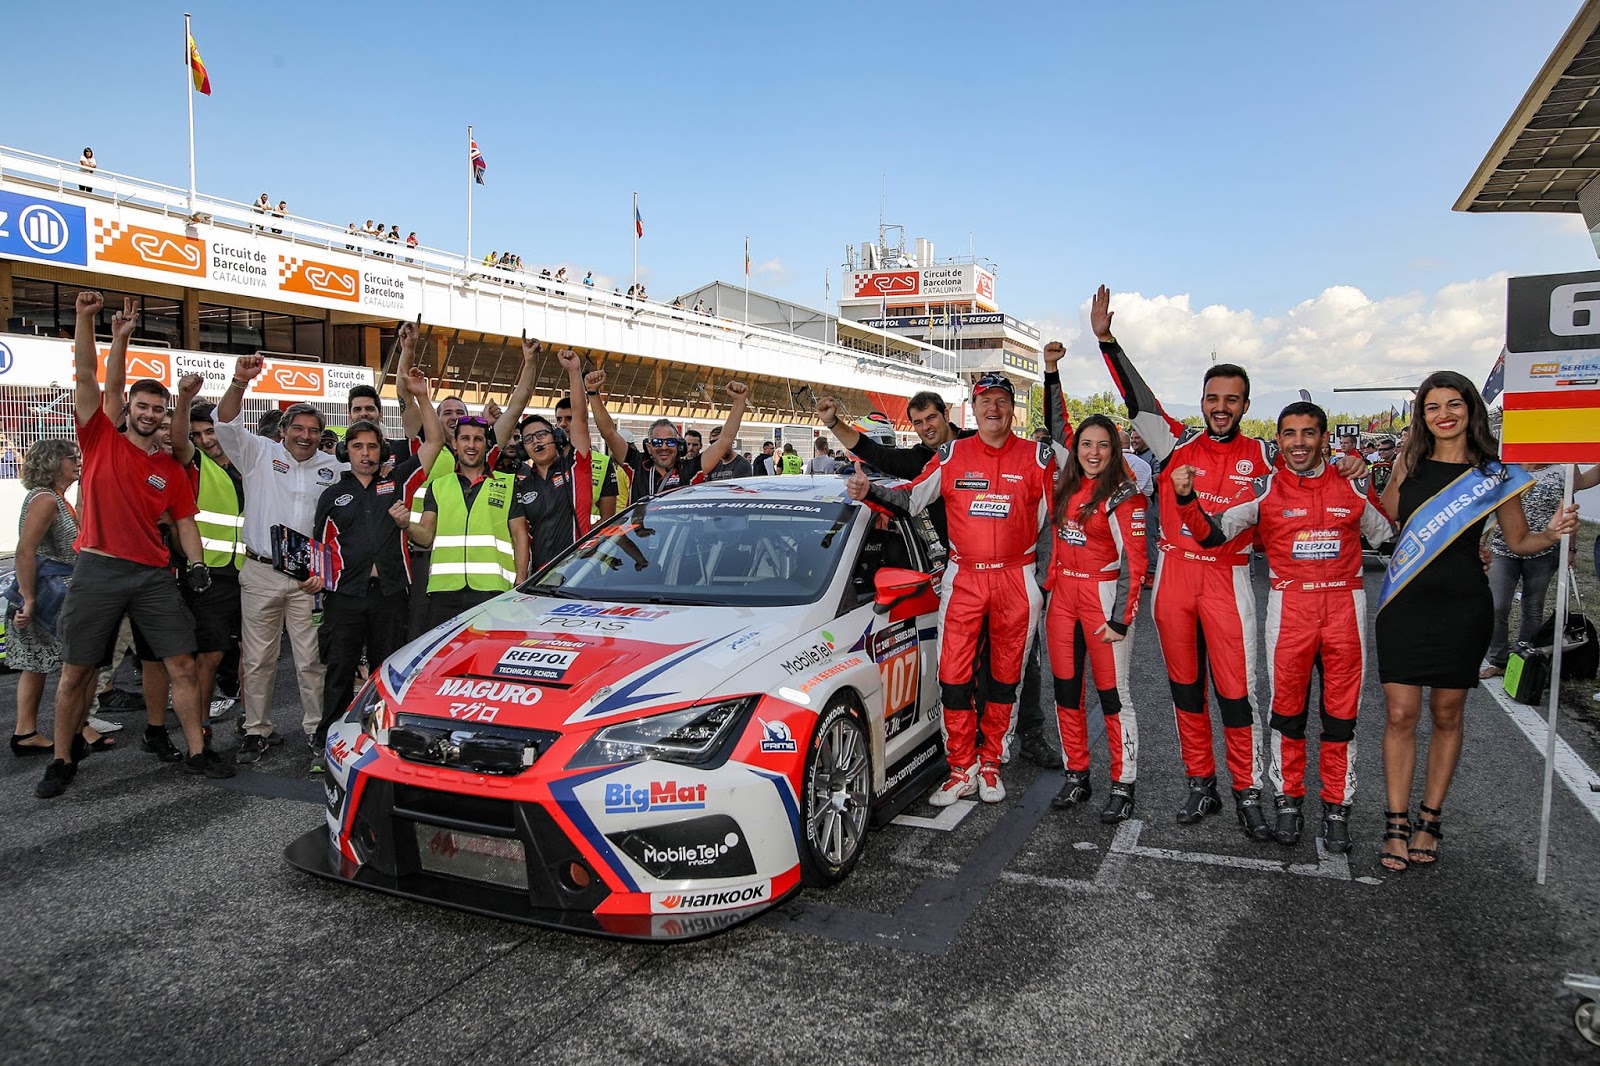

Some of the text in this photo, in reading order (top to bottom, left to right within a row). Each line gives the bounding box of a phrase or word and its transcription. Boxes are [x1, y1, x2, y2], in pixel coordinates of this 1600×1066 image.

[212, 243, 267, 263] Circuit de
[213, 256, 267, 276] Barcelona
[212, 270, 267, 288] CATALUNYA
[364, 272, 404, 289] Circuit de
[923, 269, 962, 278] Circuit de
[923, 279, 962, 287] Barcelona
[923, 286, 962, 294] CATALUNYA
[364, 284, 405, 300] Barcelona
[363, 296, 405, 310] CATALUNYA
[868, 319, 900, 327] REPSOL
[918, 317, 950, 326] REPSO
[968, 315, 1002, 323] REPSOL
[176, 355, 225, 370] Circuit de
[328, 369, 365, 381] Circuit de
[328, 380, 365, 389] Barcelo
[1193, 489, 1232, 504] RTHGA
[745, 503, 822, 513] BARCELONA
[972, 502, 1008, 511] REPSOL
[1296, 542, 1337, 551] REPSOL
[551, 603, 671, 619] BigMat
[539, 617, 631, 631] POAS
[506, 650, 569, 665] REPSOL
[780, 641, 833, 676] MobileTel
[499, 666, 559, 679] TECHNICAL SCHOOL
[881, 650, 917, 716] 107
[435, 678, 543, 706] MAGURO
[449, 702, 500, 723] マグロ
[763, 742, 795, 750] FRIME
[604, 781, 708, 813] BigMat
[643, 843, 719, 863] MobileTel
